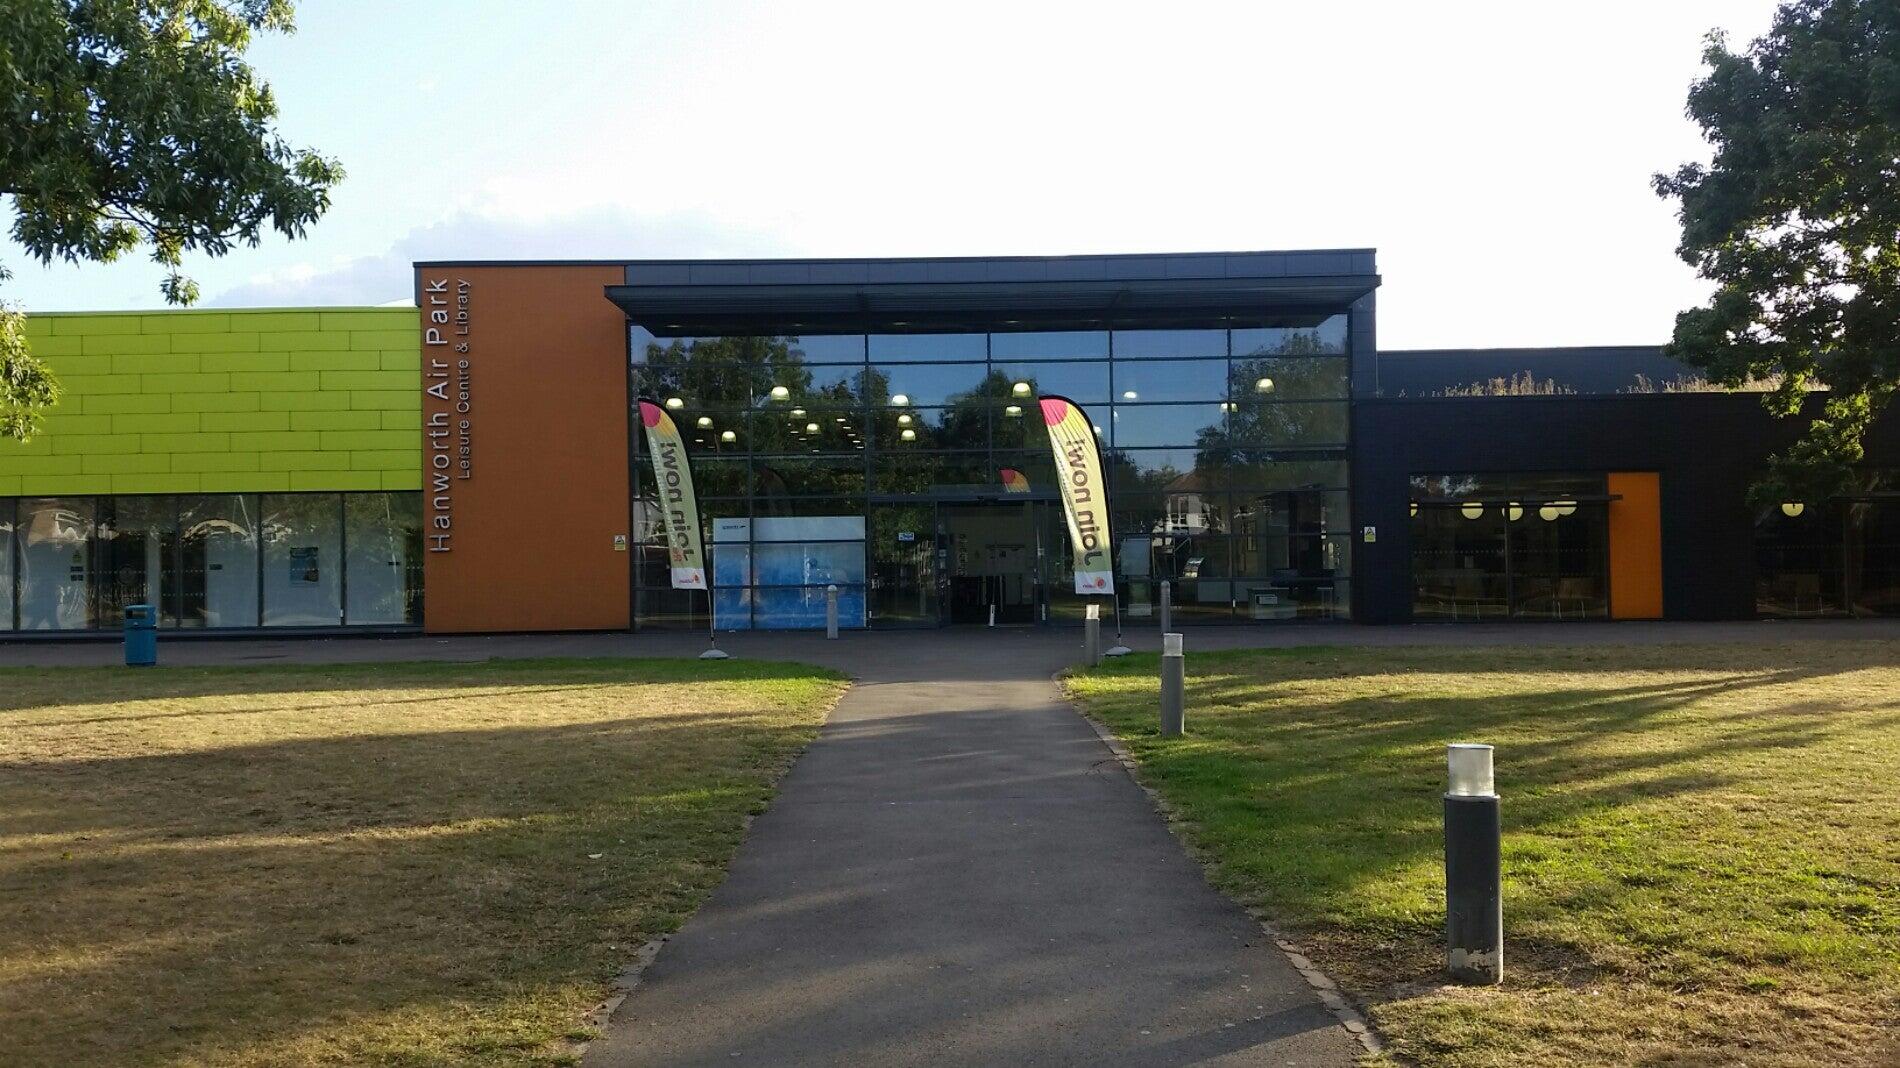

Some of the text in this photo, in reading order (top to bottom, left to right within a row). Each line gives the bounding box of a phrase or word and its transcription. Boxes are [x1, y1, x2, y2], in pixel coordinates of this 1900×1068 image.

[425, 278, 451, 552] Hanworth Air Park
[454, 278, 472, 479] Leisure Centre & Library
